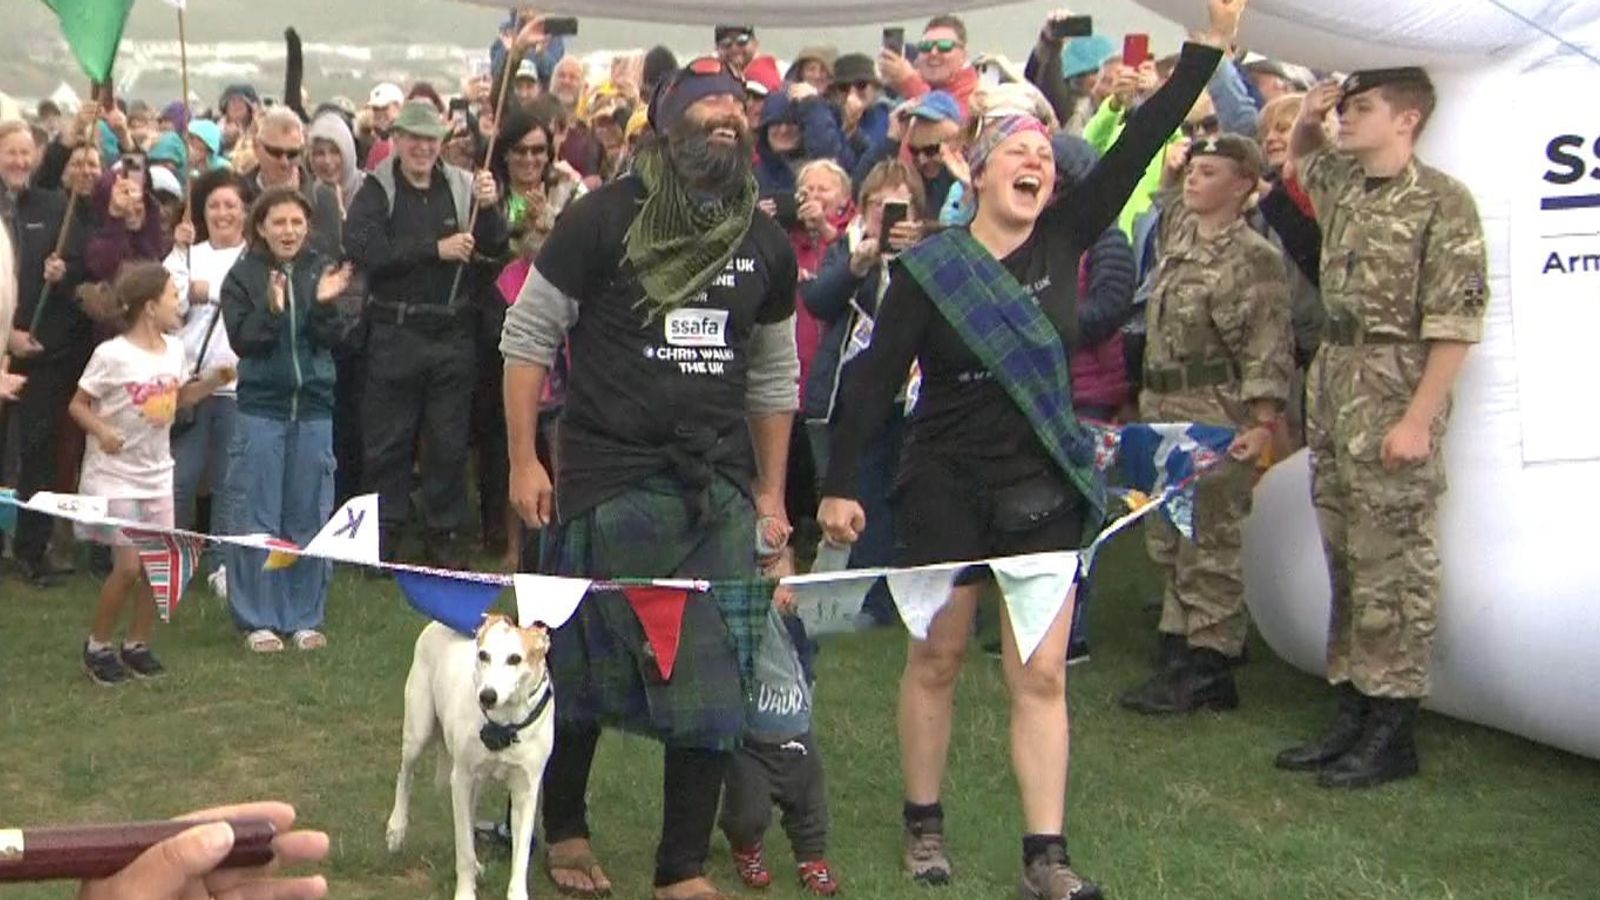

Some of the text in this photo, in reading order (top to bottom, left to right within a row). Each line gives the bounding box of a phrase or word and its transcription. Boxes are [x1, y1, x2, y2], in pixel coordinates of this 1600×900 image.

[736, 258, 755, 272] UK
[712, 274, 735, 287] NE
[671, 317, 718, 335] ssafa
[678, 361, 725, 375] THE UK
